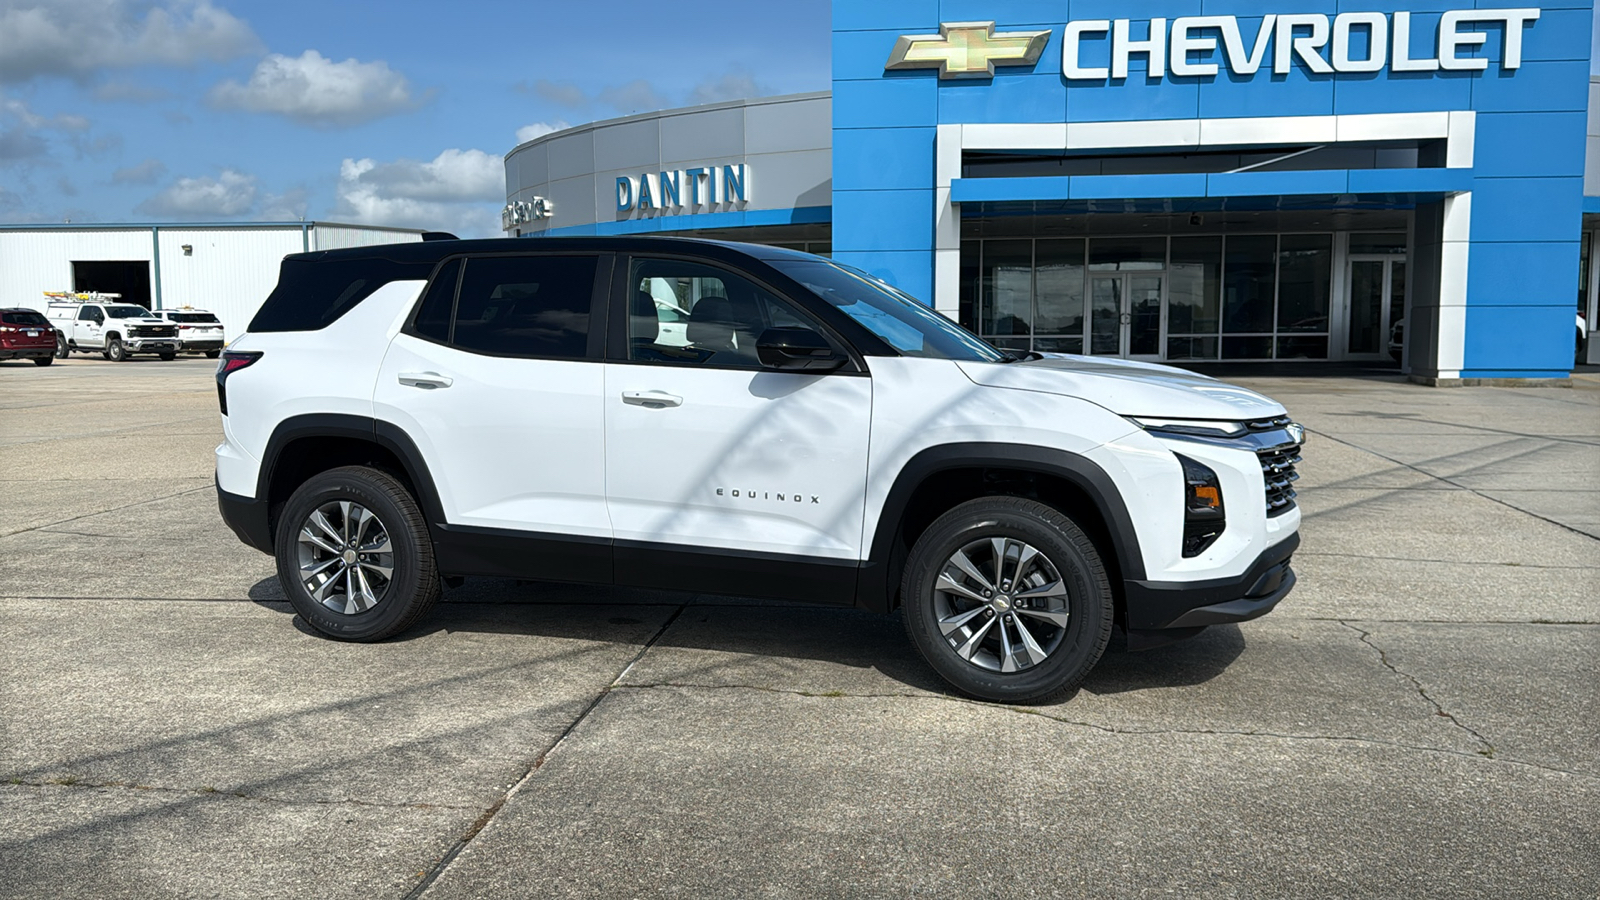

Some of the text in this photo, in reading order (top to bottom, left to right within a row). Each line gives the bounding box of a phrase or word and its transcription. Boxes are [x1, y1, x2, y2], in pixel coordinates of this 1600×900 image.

[1063, 8, 1540, 80] CHEVROLET
[615, 163, 748, 212] DANTIN
[716, 488, 819, 504] EQUINOX
